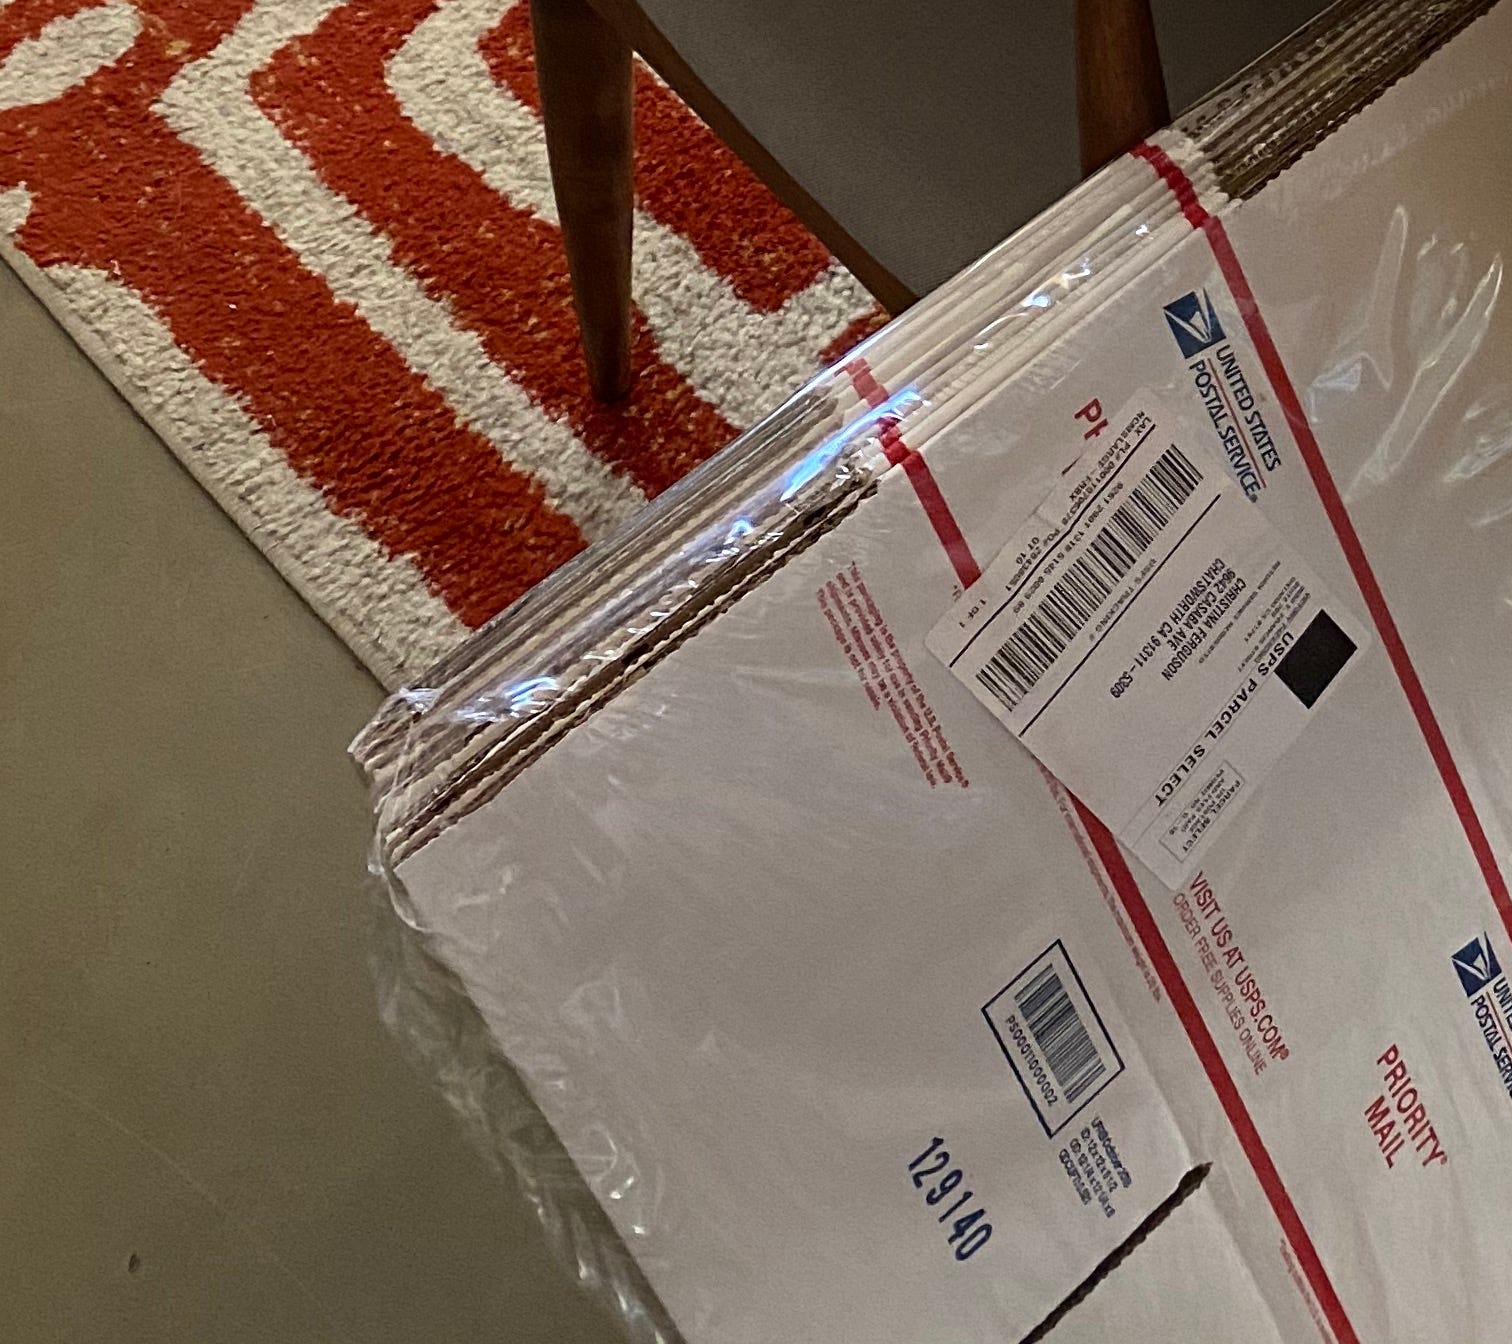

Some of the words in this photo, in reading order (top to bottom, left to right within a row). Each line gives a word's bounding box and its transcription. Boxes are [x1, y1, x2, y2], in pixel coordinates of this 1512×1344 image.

[1189, 359, 1227, 427] POSTAL
[1216, 345, 1254, 411] UNITED
[1245, 410, 1281, 472] STATES
[1169, 558, 1226, 625] CHATSWORTH
[1183, 591, 1218, 631] CASABA
[1200, 578, 1247, 629] CHRISTINA
[1156, 621, 1173, 639] CA
[1161, 628, 1208, 681] FERGUSON
[1167, 627, 1188, 652] AVE
[1257, 631, 1294, 676] USPS
[1205, 678, 1259, 741] PARCEL
[1155, 745, 1206, 806] SELECT
[1189, 870, 1221, 920] VISIT
[1211, 917, 1233, 948] US
[1223, 945, 1245, 969] AT
[1172, 892, 1201, 942] ORDER
[1196, 937, 1217, 973] FREE
[1210, 968, 1245, 1030] SUPPLIES
[1239, 1027, 1267, 1076] ONLINE
[1470, 995, 1502, 1053] POSTAL
[1365, 1095, 1404, 1169] MAIL
[908, 1137, 992, 1261] 129140
